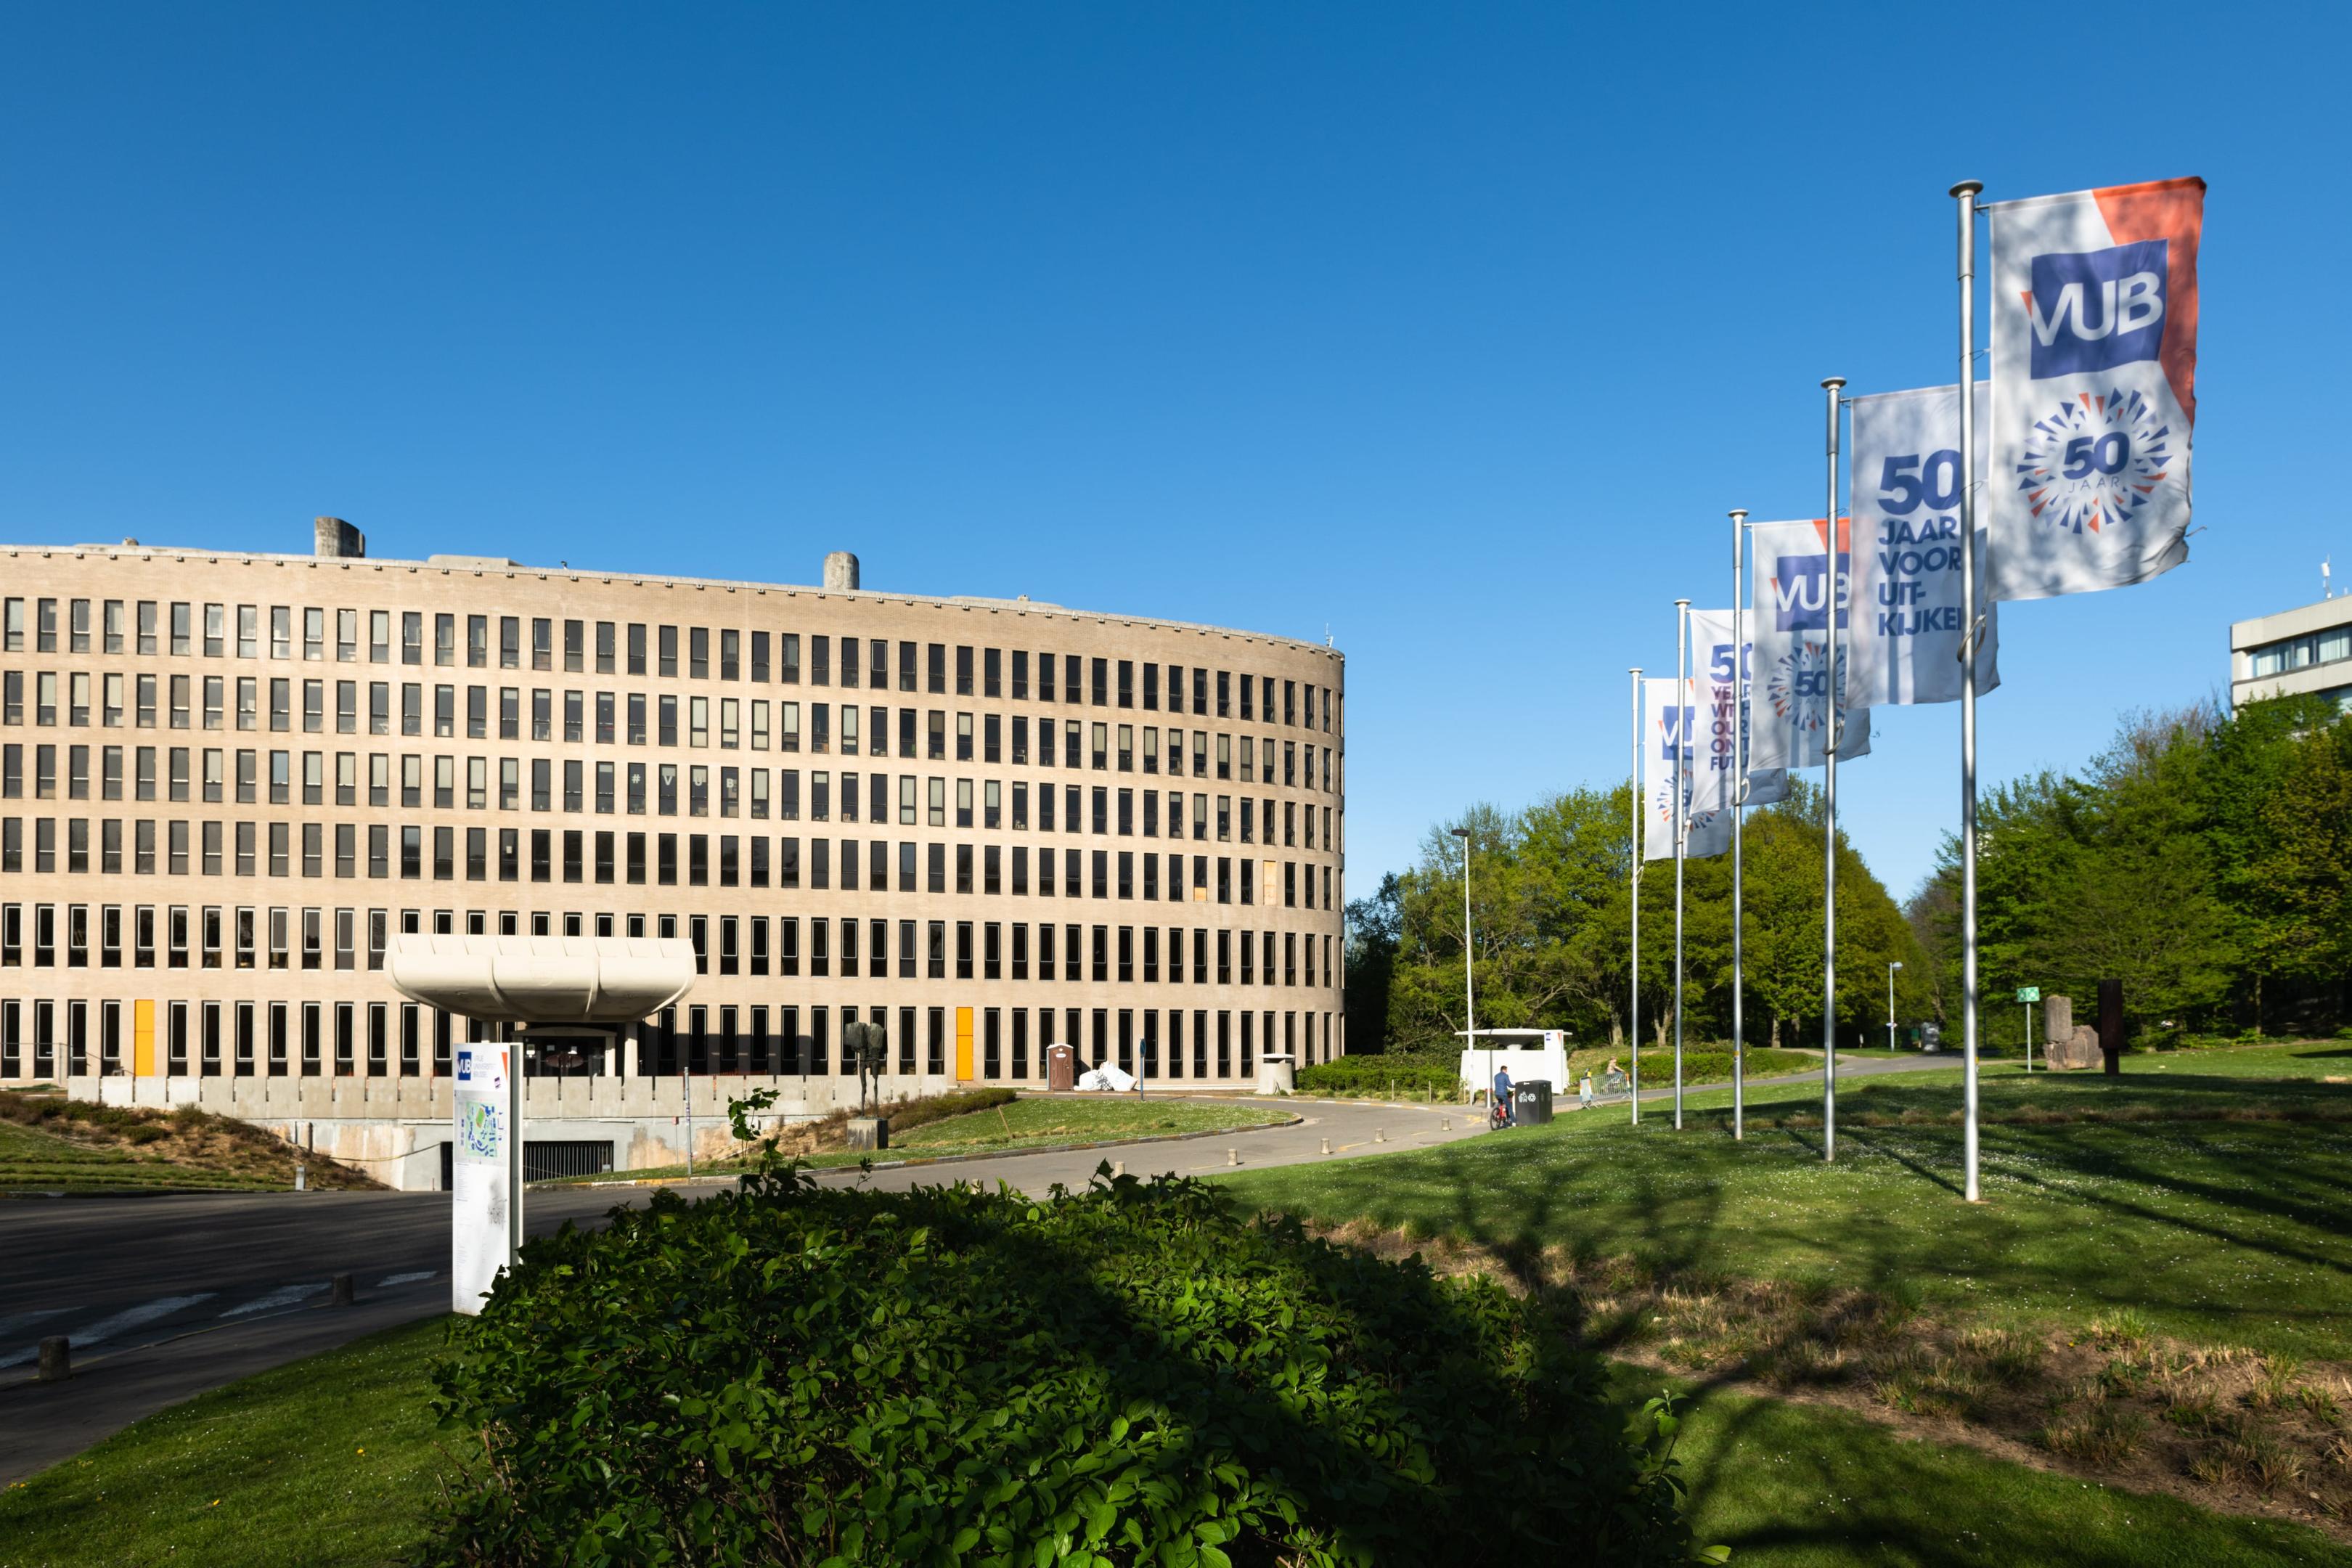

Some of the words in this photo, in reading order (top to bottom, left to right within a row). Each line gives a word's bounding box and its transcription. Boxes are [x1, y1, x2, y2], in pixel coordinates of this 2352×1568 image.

[2021, 271, 2163, 346] VUB
[2062, 432, 2130, 480] 50
[1877, 449, 1961, 515] 50
[2068, 476, 2120, 494] JAAR
[1878, 516, 1957, 545] JAAR
[1878, 546, 1961, 575] VOOR
[1770, 572, 1850, 612] VUB
[1879, 581, 1926, 605] UIT-
[1878, 607, 1961, 636] KIJKE
[1794, 670, 1827, 697] 50
